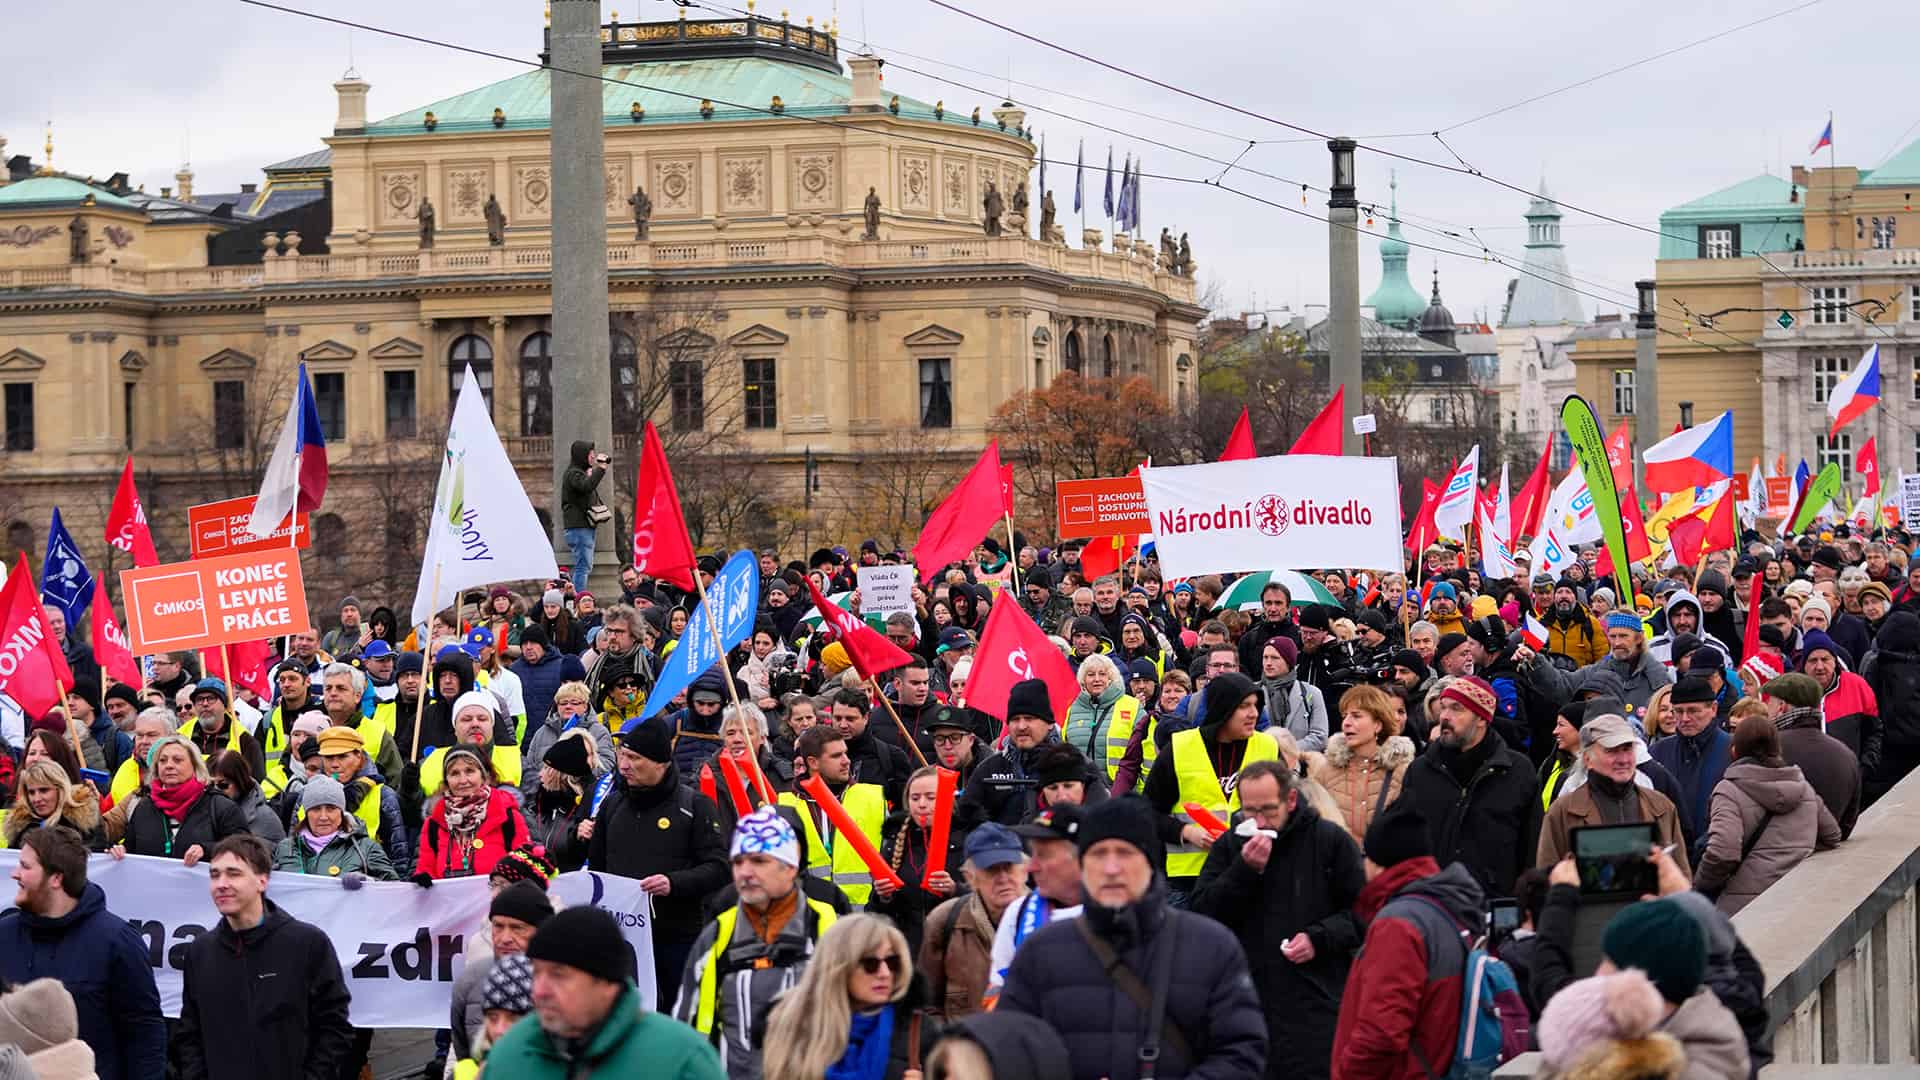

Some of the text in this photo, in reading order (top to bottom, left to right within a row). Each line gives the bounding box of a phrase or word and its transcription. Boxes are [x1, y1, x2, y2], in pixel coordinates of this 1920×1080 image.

[1159, 500, 1372, 536] Národní divadlo
[215, 562, 288, 587] KONEC
[153, 598, 205, 616] ČMKOS
[218, 582, 287, 609] LEVNÉ
[223, 607, 292, 632] PRÁCE
